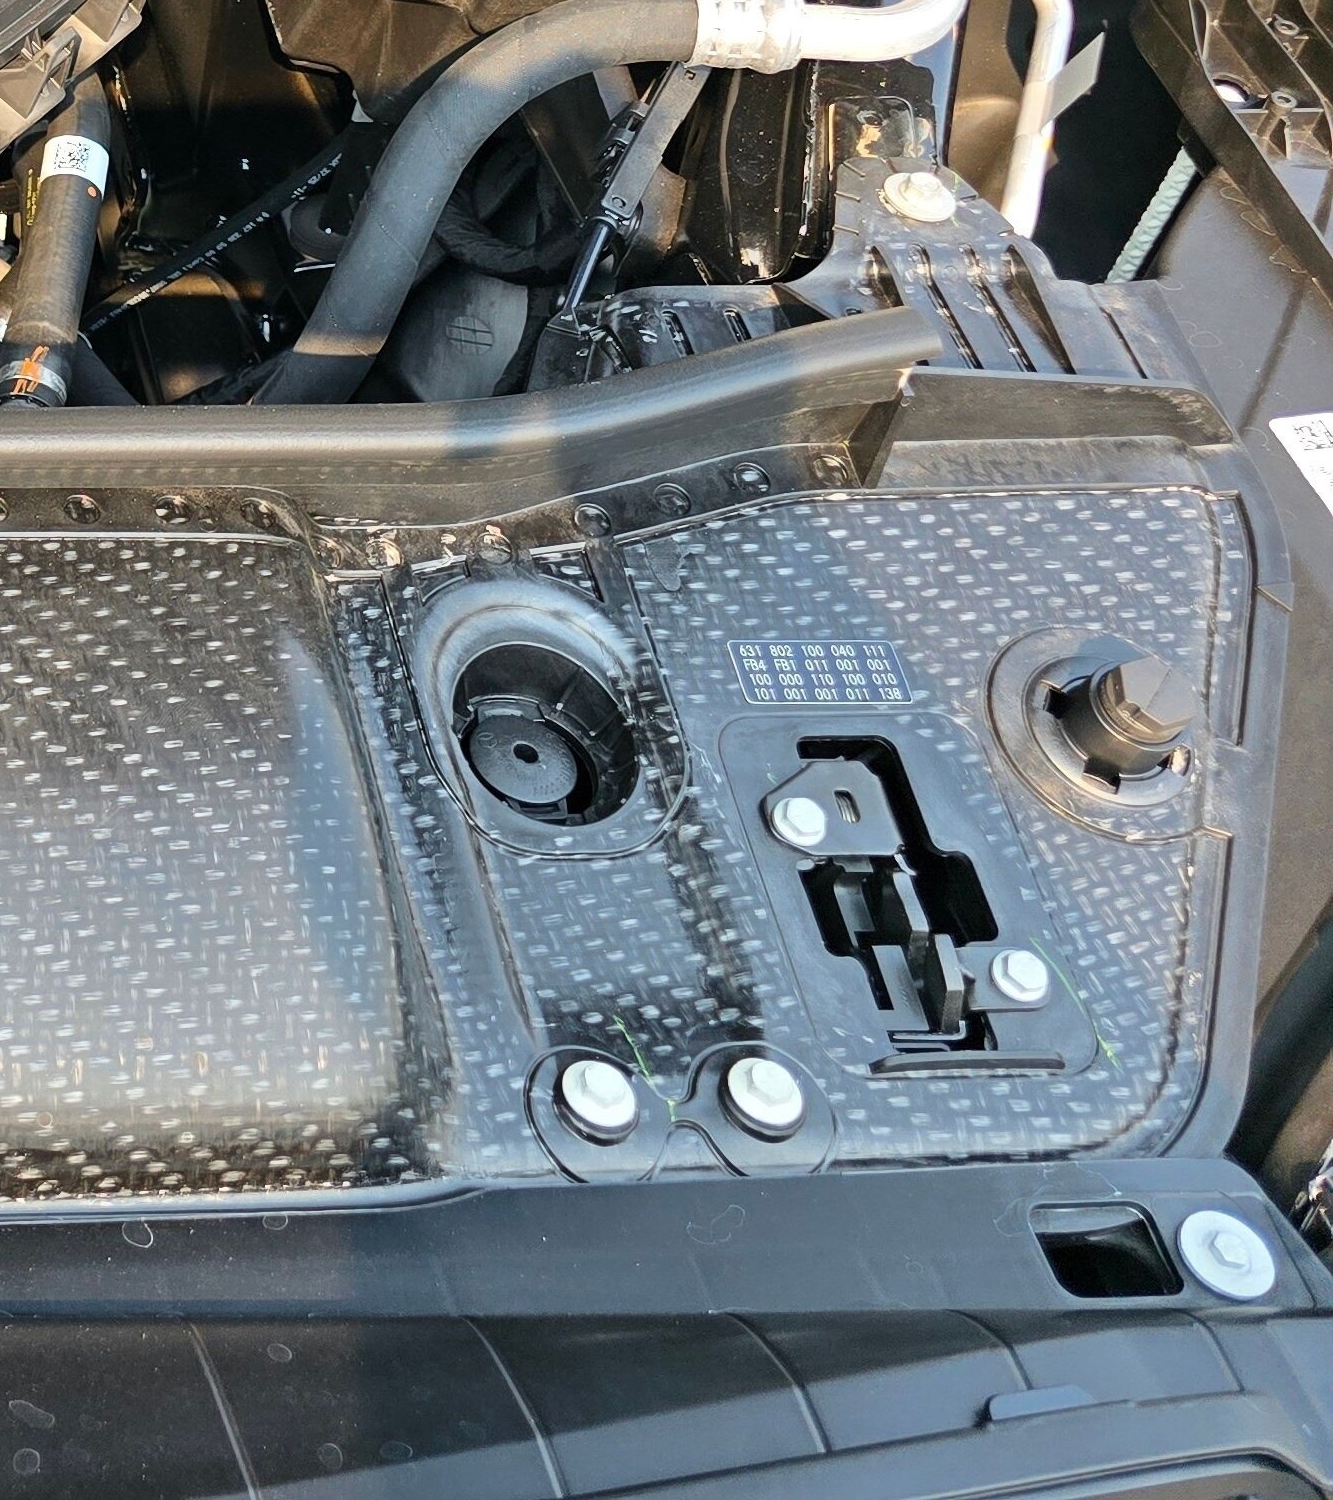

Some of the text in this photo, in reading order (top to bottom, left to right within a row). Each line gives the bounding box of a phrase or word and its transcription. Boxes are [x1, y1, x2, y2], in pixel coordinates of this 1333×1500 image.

[739, 645, 885, 657] 631 802 100 040 111
[743, 659, 891, 672] FB4 FB1 011 001 001
[750, 674, 897, 686] 100 000 110 100 010
[755, 688, 903, 700] 101 001 001 011 138
